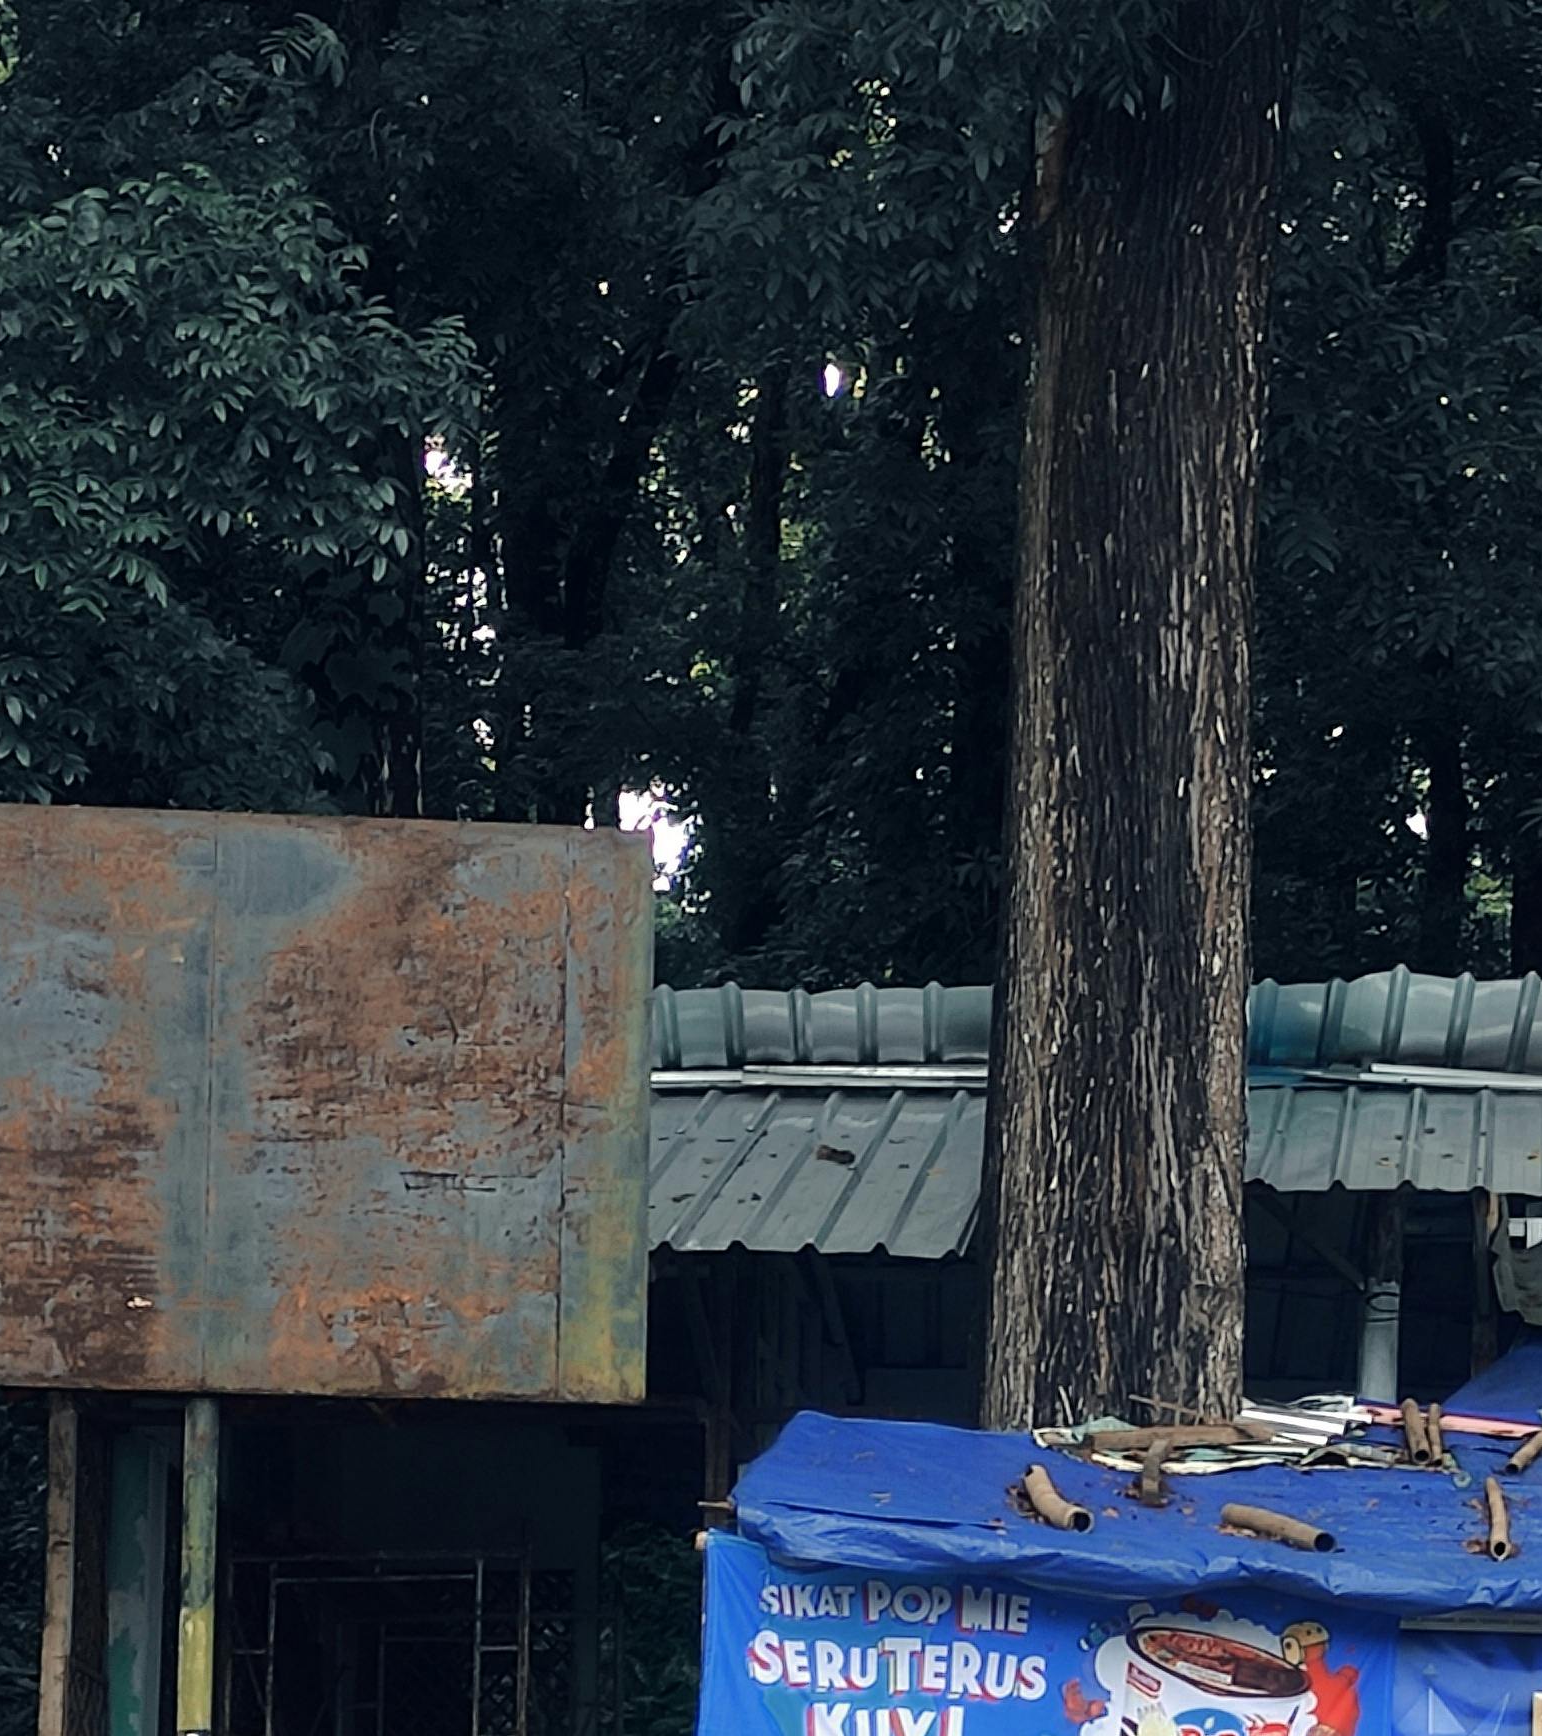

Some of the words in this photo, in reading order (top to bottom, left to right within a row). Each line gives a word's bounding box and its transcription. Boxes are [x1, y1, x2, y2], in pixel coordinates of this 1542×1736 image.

[759, 1581, 856, 1619] SIKAT
[864, 1580, 952, 1626] POP
[960, 1587, 1030, 1635] MIE
